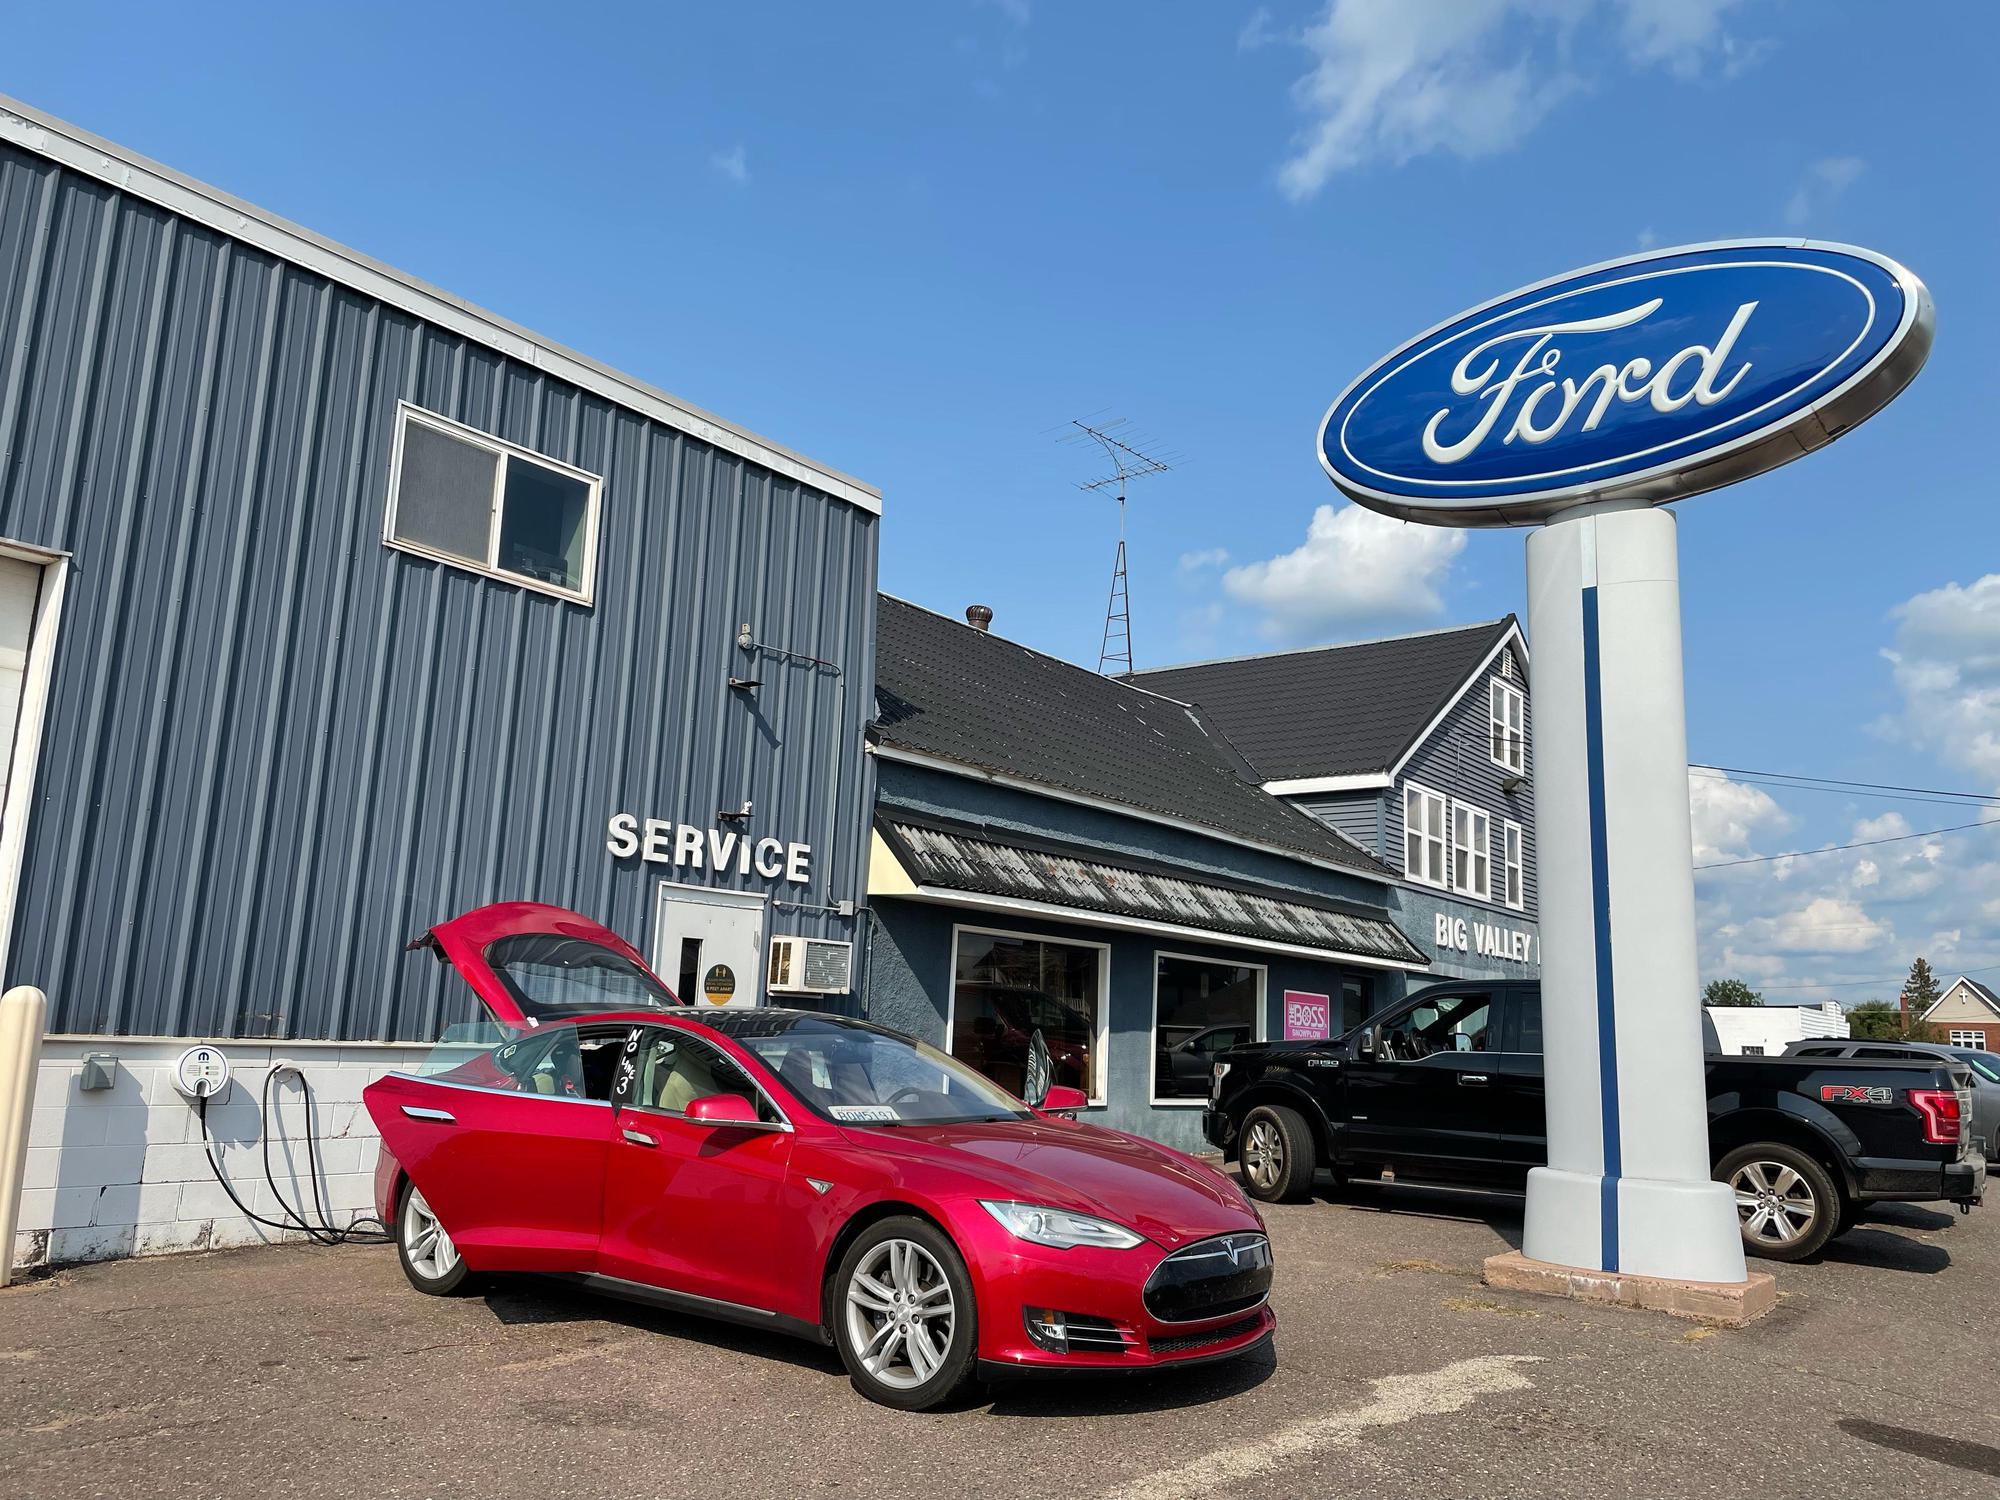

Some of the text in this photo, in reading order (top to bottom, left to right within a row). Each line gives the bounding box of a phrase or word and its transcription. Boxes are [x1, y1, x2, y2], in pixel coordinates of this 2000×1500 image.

[1422, 297, 1759, 464] Ford
[607, 813, 811, 883] SERVICE
[1435, 912, 1468, 951] BIG
[1473, 922, 1531, 962] VALLEY
[1293, 1003, 1324, 1028] BOSS
[616, 1076, 629, 1095] 3
[1820, 1085, 1893, 1102] FX4
